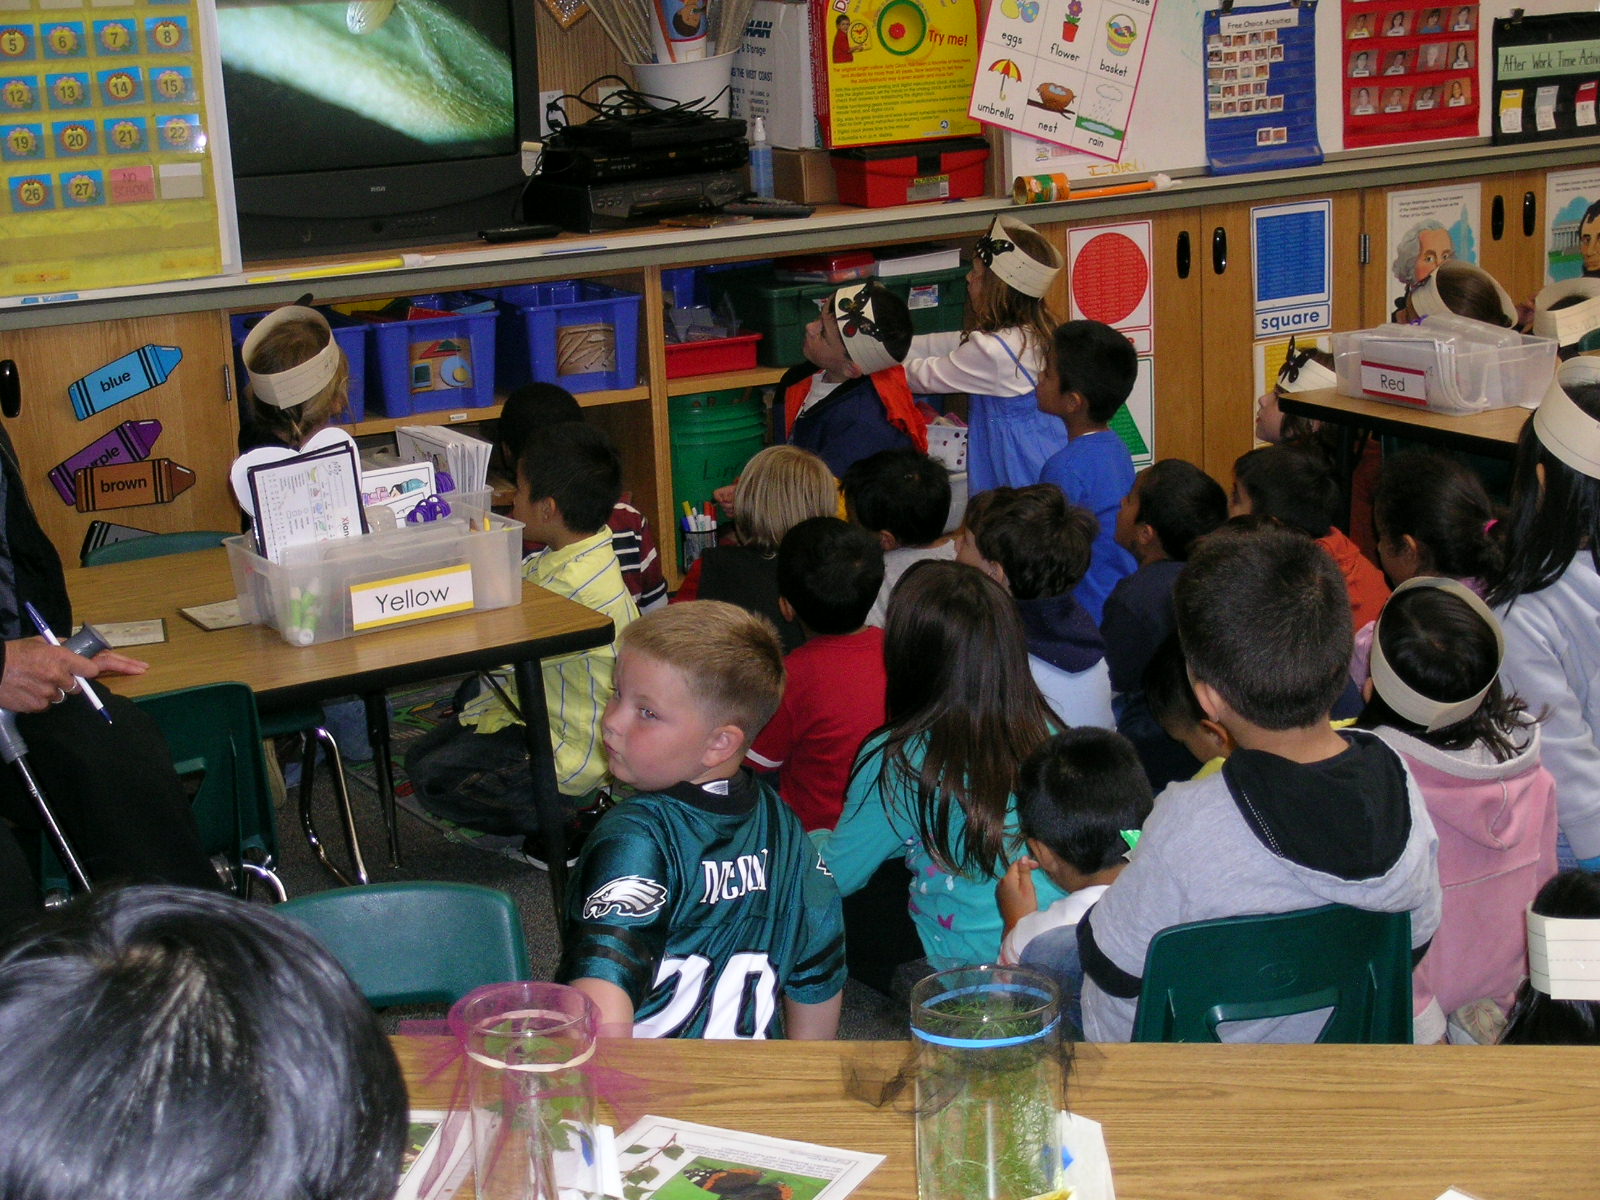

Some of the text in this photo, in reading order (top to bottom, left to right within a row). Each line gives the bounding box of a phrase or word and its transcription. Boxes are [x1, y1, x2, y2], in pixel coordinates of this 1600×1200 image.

[1243, 20, 1263, 28] Choice
[1265, 17, 1292, 25] Activities
[58, 35, 68, 49] 6
[110, 32, 119, 45] 7
[163, 30, 172, 44] 8
[928, 29, 968, 47] Try me!
[1001, 31, 1023, 48] eggs
[9, 37, 18, 52] 5
[1050, 42, 1081, 63] flower
[1503, 54, 1526, 72] After
[1531, 51, 1553, 69] Work
[1558, 49, 1576, 67] Time
[1099, 58, 1128, 78] basket
[60, 85, 76, 99] 13
[113, 81, 129, 95] 14
[163, 79, 178, 93] 15
[9, 89, 25, 103] 12
[977, 102, 1015, 121] umbrella
[170, 126, 186, 140] 22
[1037, 120, 1059, 134] nest
[13, 135, 29, 150] 19
[68, 133, 84, 147] 20
[118, 129, 134, 143] 21
[1088, 136, 1105, 148] rain
[122, 173, 137, 183] NO
[24, 187, 40, 201] 26
[75, 182, 90, 196] 27
[114, 182, 151, 195] SCHOOL
[1261, 311, 1320, 331] square
[100, 371, 131, 393] blue
[1380, 373, 1406, 392] Red
[101, 477, 147, 493] brown
[375, 585, 450, 614] Yellow
